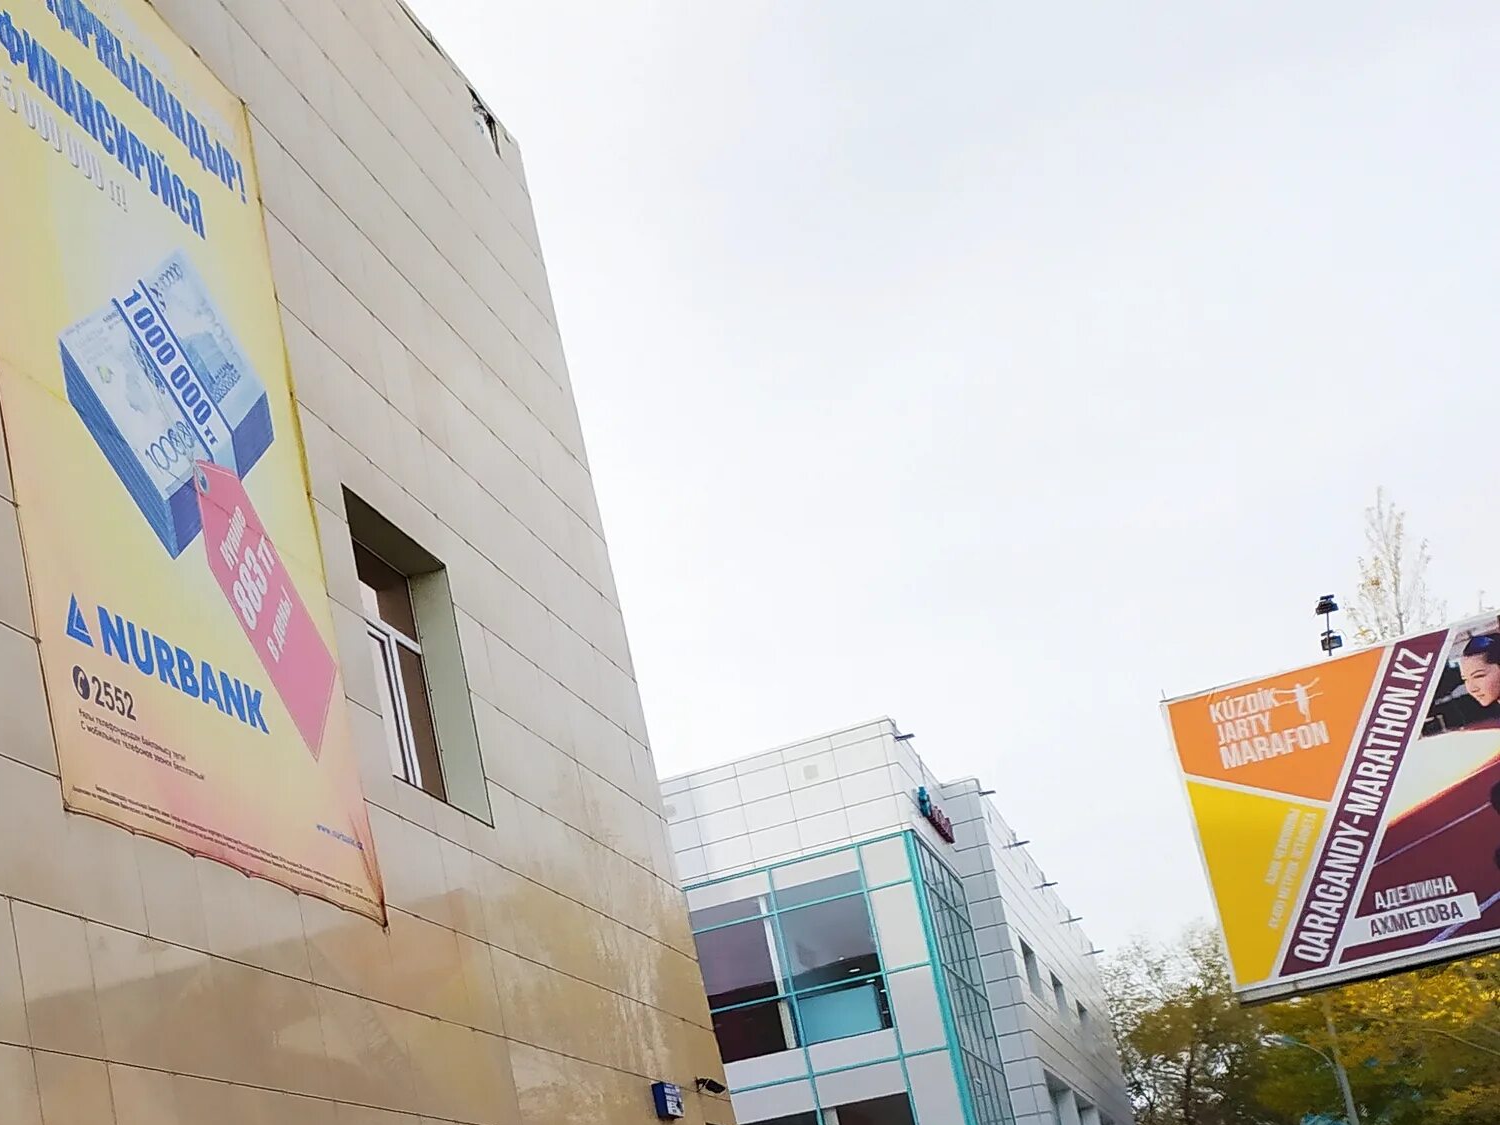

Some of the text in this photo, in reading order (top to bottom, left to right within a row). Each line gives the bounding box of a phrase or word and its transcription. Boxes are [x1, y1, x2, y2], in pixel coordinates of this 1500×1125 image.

[232, 545, 268, 631] 883
[97, 605, 270, 735] NURBANK
[92, 676, 137, 721] 2552
[1217, 711, 1271, 746] JARTY
[1220, 720, 1330, 769] MARAFON
[1294, 647, 1434, 963] QARAGANDY-MARATHON.KZ
[1374, 875, 1458, 910] АДЕЛИНА
[1369, 901, 1463, 938] АХМЕТОВА
